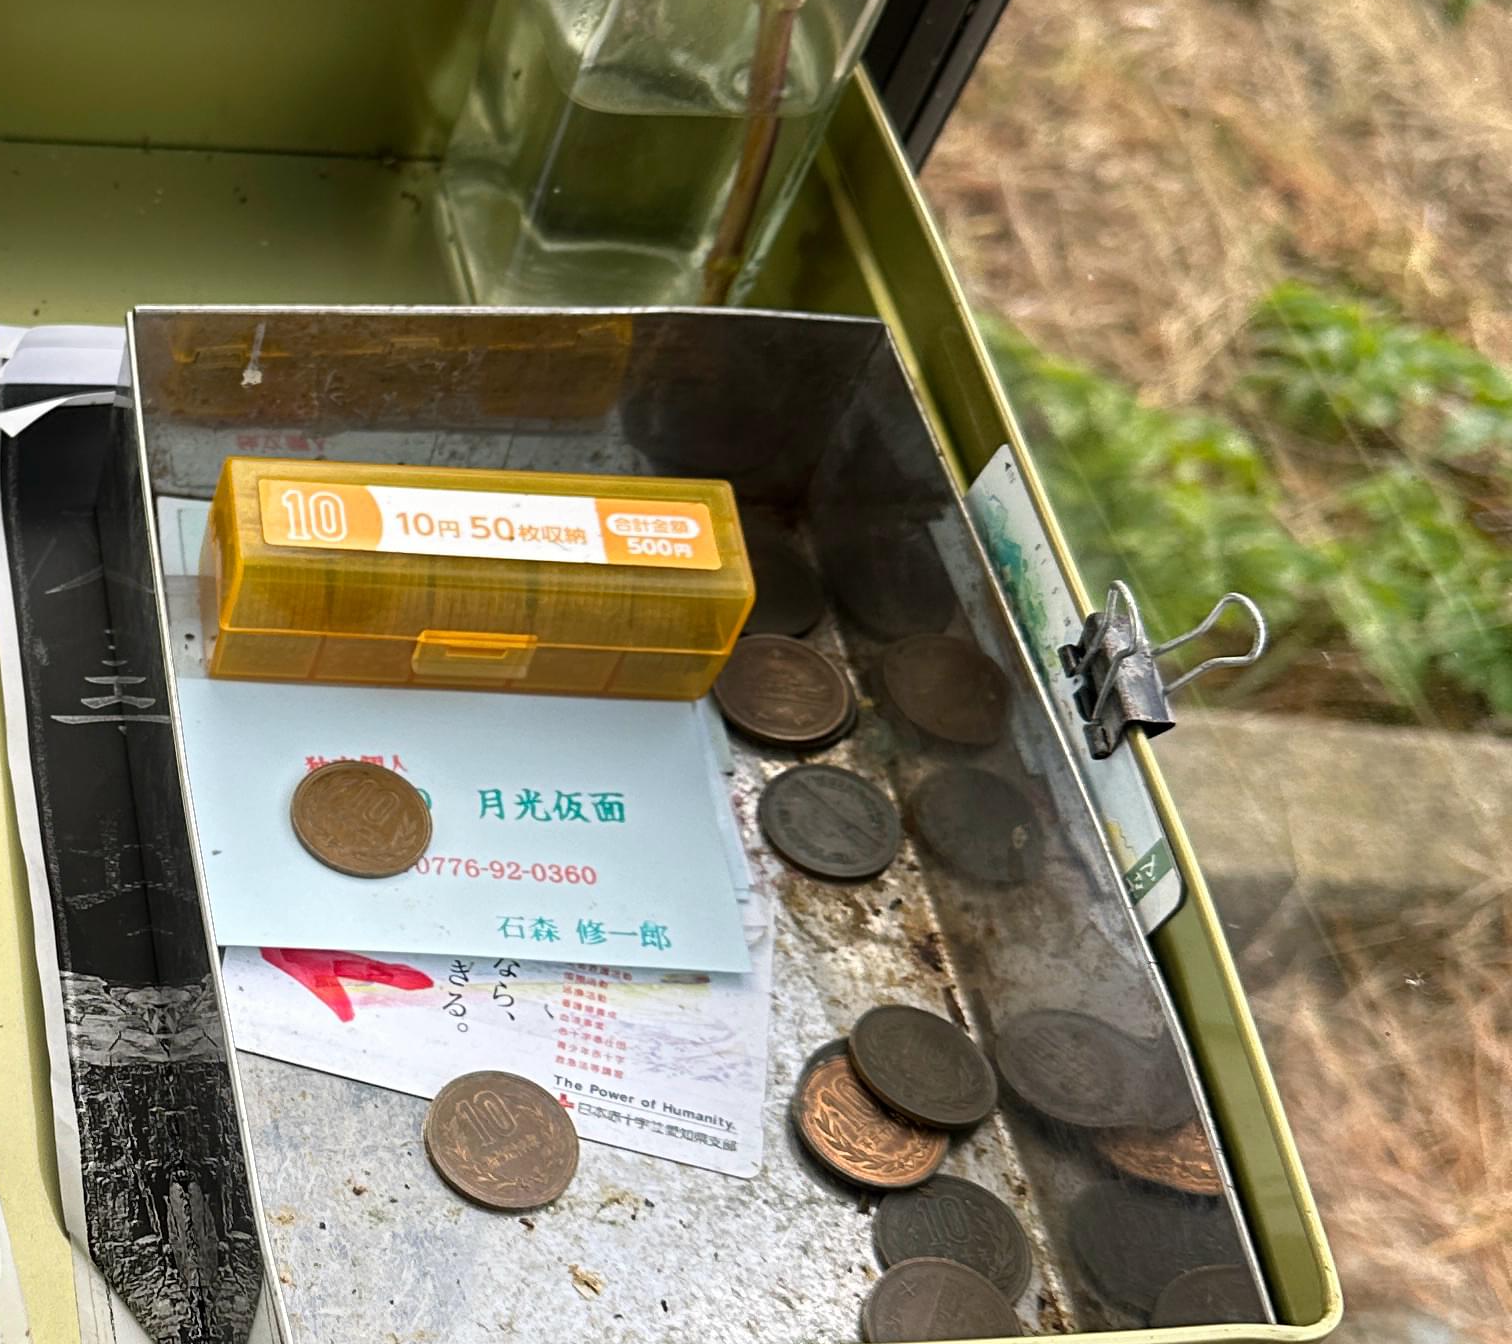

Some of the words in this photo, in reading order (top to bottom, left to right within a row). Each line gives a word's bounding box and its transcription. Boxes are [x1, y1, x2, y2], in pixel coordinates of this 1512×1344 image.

[281, 489, 348, 542] 10
[396, 512, 461, 538] 10円
[627, 537, 693, 559] 500円
[477, 788, 626, 824] 月光仮面
[415, 856, 598, 886] 0776-92-0360
[496, 915, 562, 943] 石森
[576, 918, 671, 952] 修一郎
[553, 1074, 583, 1092] The
[590, 1085, 635, 1104] Power
[641, 1098, 657, 1110] of
